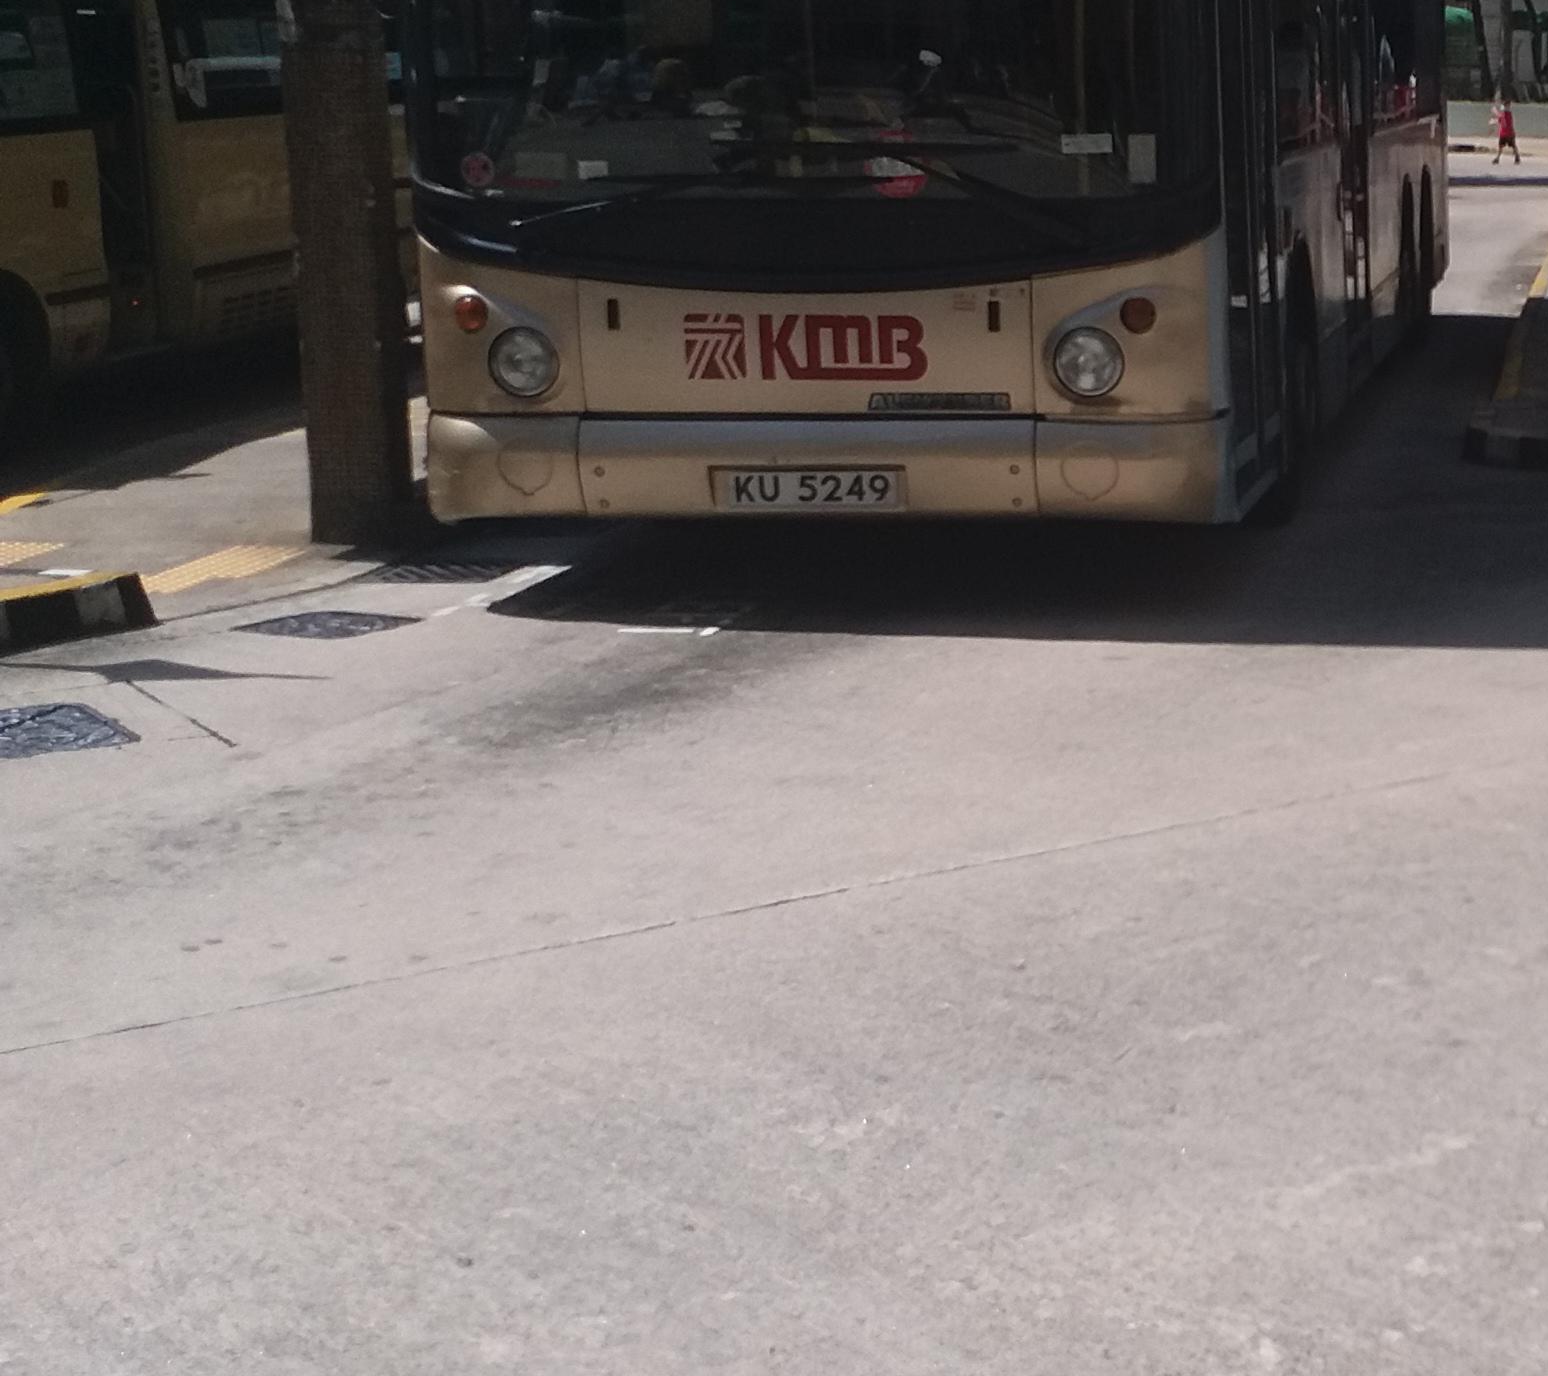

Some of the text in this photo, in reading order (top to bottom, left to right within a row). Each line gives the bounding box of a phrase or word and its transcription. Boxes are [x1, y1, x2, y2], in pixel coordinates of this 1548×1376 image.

[758, 313, 929, 382] KMB
[734, 475, 890, 502] KU 5249
